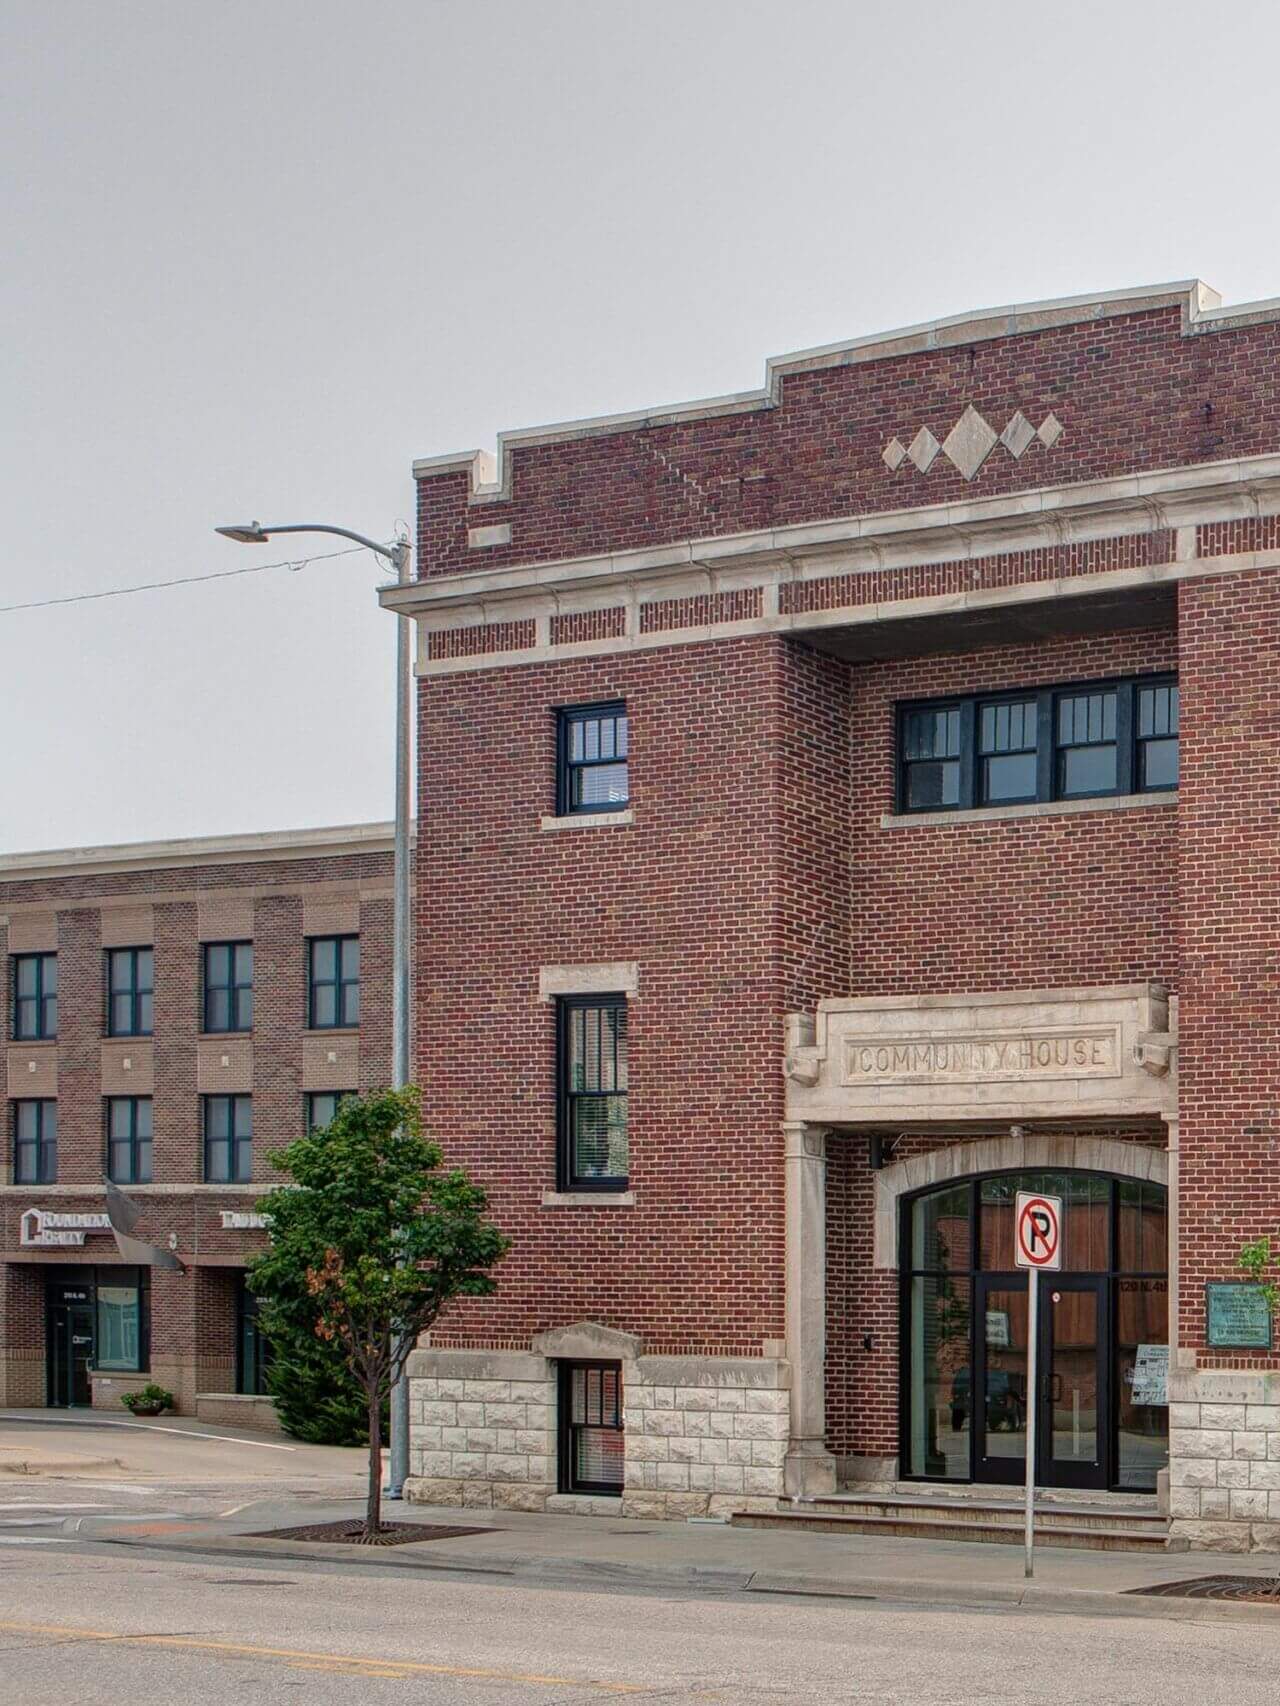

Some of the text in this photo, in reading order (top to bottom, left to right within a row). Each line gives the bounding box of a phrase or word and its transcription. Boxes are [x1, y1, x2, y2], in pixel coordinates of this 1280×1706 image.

[859, 1039, 1106, 1073] COMMUNITY HOUSE
[1031, 1212, 1050, 1252] P
